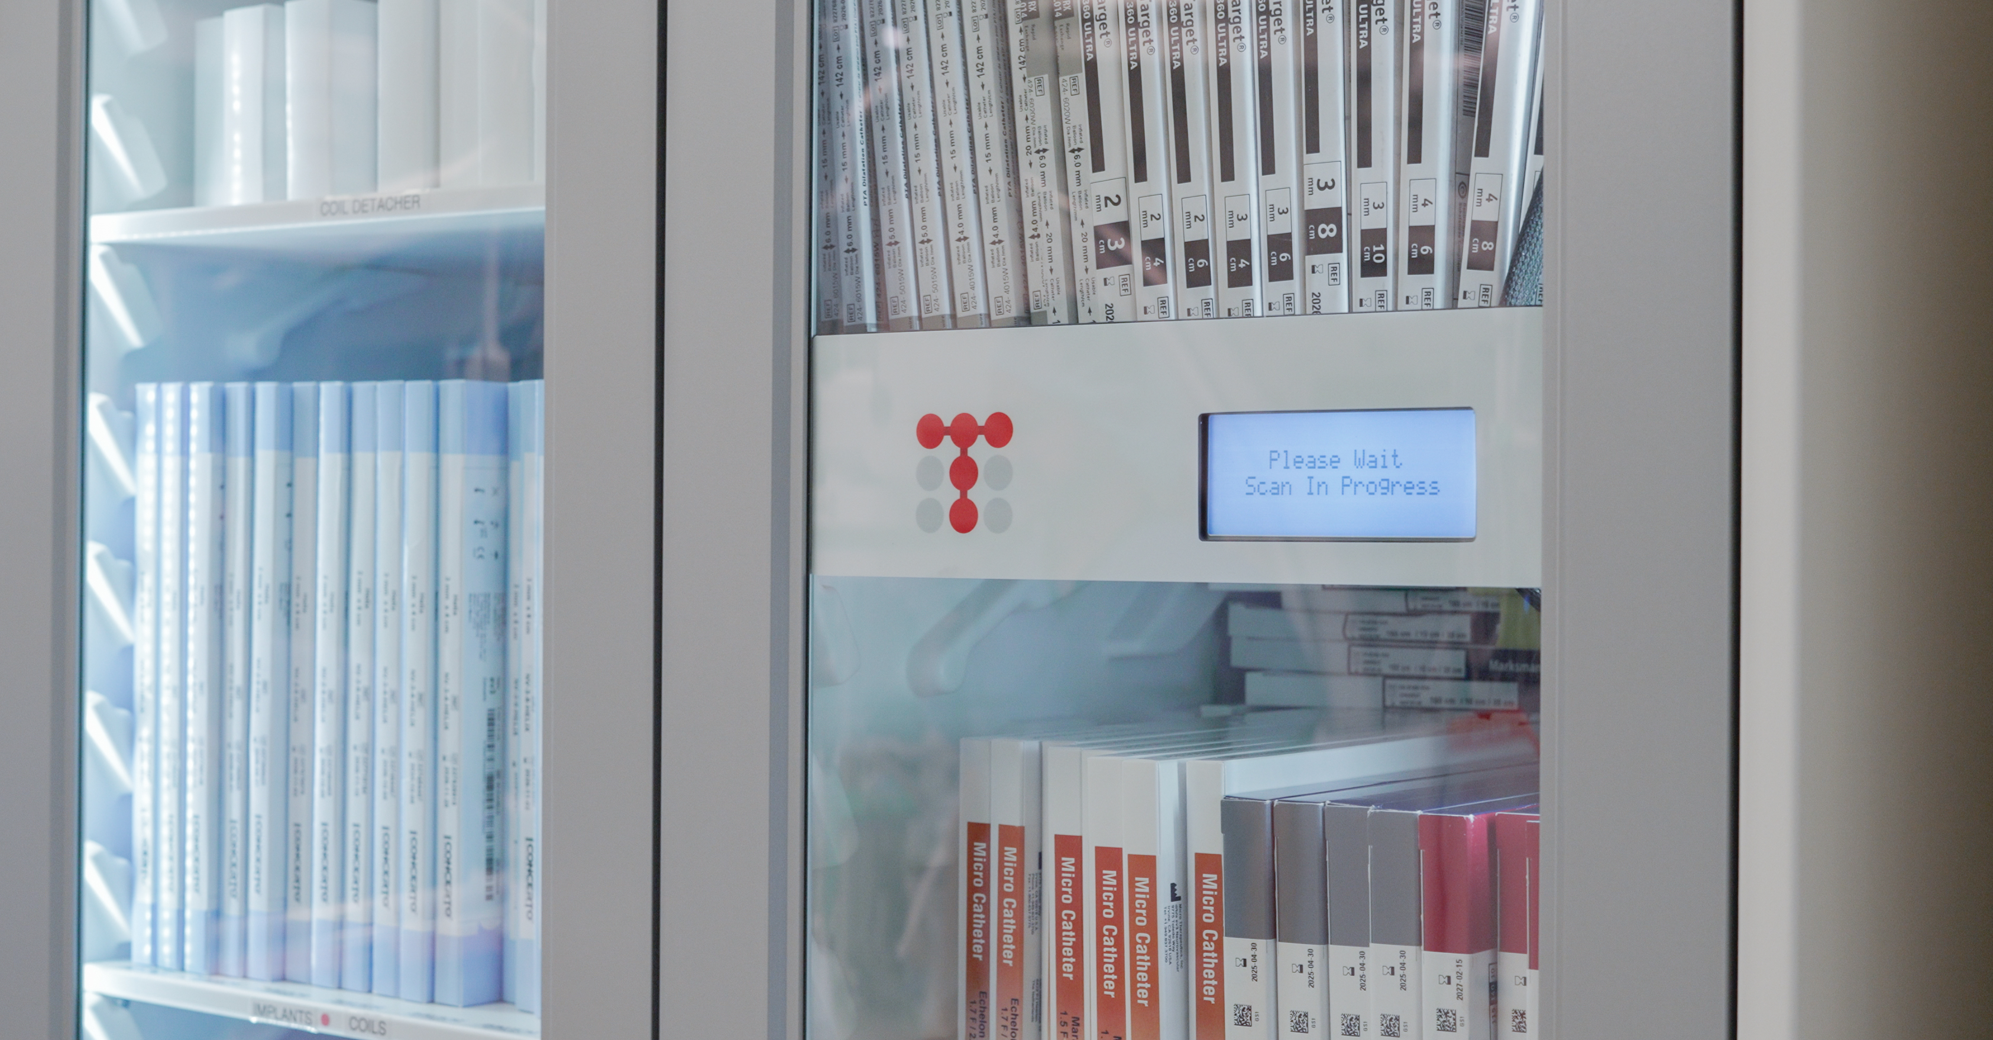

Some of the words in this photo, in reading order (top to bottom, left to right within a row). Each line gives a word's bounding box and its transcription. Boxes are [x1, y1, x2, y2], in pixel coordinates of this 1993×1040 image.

[1028, 1, 1036, 12] RX
[1063, 0, 1071, 12] RX
[1126, 2, 1134, 24] 360
[1169, 1, 1178, 23] 360
[1359, 4, 1368, 49] ULTRA
[1412, 0, 1422, 43] ULTRA
[1019, 38, 1026, 52] cm
[1084, 22, 1094, 62] ULTRA
[1217, 23, 1227, 66] ULTRA
[1258, 16, 1268, 59] ULTRA
[906, 47, 913, 61] cm
[941, 44, 948, 58] cm
[976, 46, 983, 60] cm
[1128, 28, 1138, 70] ULTRA
[1170, 27, 1181, 70] ULTRA
[836, 56, 842, 70] cm
[874, 50, 880, 64] cm
[1018, 55, 1026, 70] 142
[906, 63, 914, 79] 142
[940, 60, 949, 76] 142
[976, 62, 984, 78] 142
[914, 134, 920, 150] mm
[950, 130, 955, 147] mm
[985, 133, 990, 150] mm
[1026, 126, 1030, 142] mm
[842, 142, 846, 158] mm
[882, 136, 887, 152] mm
[914, 152, 920, 163] 15
[950, 150, 956, 160] 15
[985, 153, 991, 163] 15
[1040, 171, 1046, 188] mm
[1075, 170, 1082, 186] mm
[1317, 178, 1336, 191] 3
[1308, 177, 1314, 196] mm
[1096, 194, 1102, 212] mm
[1104, 194, 1122, 208] 2
[1412, 194, 1418, 213] mm
[1421, 198, 1433, 208] 4
[1476, 188, 1483, 207] mm
[1486, 194, 1498, 202] 4
[957, 204, 963, 220] mm
[1032, 200, 1038, 217] mm
[1269, 204, 1276, 222] mm
[1278, 207, 1289, 215] 3
[1364, 198, 1370, 216] mm
[1373, 202, 1384, 210] 3
[888, 208, 894, 225] mm
[921, 207, 926, 222] mm
[992, 206, 998, 223] mm
[1142, 210, 1148, 228] mm
[1150, 213, 1161, 221] 2
[1186, 211, 1192, 229] mm
[1194, 214, 1205, 222] 2
[1228, 210, 1234, 228] mm
[1046, 232, 1053, 244] 20
[1081, 232, 1088, 243] 20
[1309, 225, 1315, 240] cm
[1318, 224, 1337, 239] 8
[1099, 240, 1105, 254] cm
[1108, 238, 1125, 250] 3
[1411, 244, 1418, 258] cm
[1420, 245, 1432, 255] 6
[1472, 238, 1479, 253] cm
[1481, 241, 1494, 251] 8
[1047, 246, 1053, 264] mm
[1082, 246, 1088, 263] mm
[1270, 251, 1277, 266] cm
[1279, 252, 1291, 262] 6
[1364, 247, 1370, 261] cm
[1373, 244, 1385, 263] 10
[1145, 257, 1151, 270] cm
[1153, 258, 1164, 267] 4
[1188, 258, 1195, 272] cm
[1197, 259, 1208, 268] 6
[1230, 258, 1236, 272] cm
[1238, 259, 1250, 268] 4
[1482, 287, 1490, 304] REF
[1269, 450, 1341, 469] Please
[1354, 449, 1402, 468] Wait
[1246, 476, 1292, 496] Scan
[1307, 476, 1328, 496] In
[1342, 476, 1440, 496] Progress
[973, 842, 986, 887] Micro
[1004, 846, 1017, 892] Micro
[1061, 857, 1075, 904] Micro
[1102, 870, 1117, 919] Micro
[1135, 877, 1150, 926] Micro
[1202, 874, 1217, 923] Micro
[972, 893, 986, 961] Catheter
[1002, 898, 1016, 967] Catheter
[1061, 910, 1076, 980] Catheter
[1103, 925, 1118, 998] Catheter
[1135, 932, 1151, 1007] Catheter
[1202, 930, 1218, 1004] Catheter
[979, 991, 987, 1038] Echelon
[1010, 998, 1019, 1040] Echelo
[1060, 1011, 1068, 1027] 1.5
[348, 1015, 386, 1036] COILS
[1072, 1016, 1080, 1040] Mar
